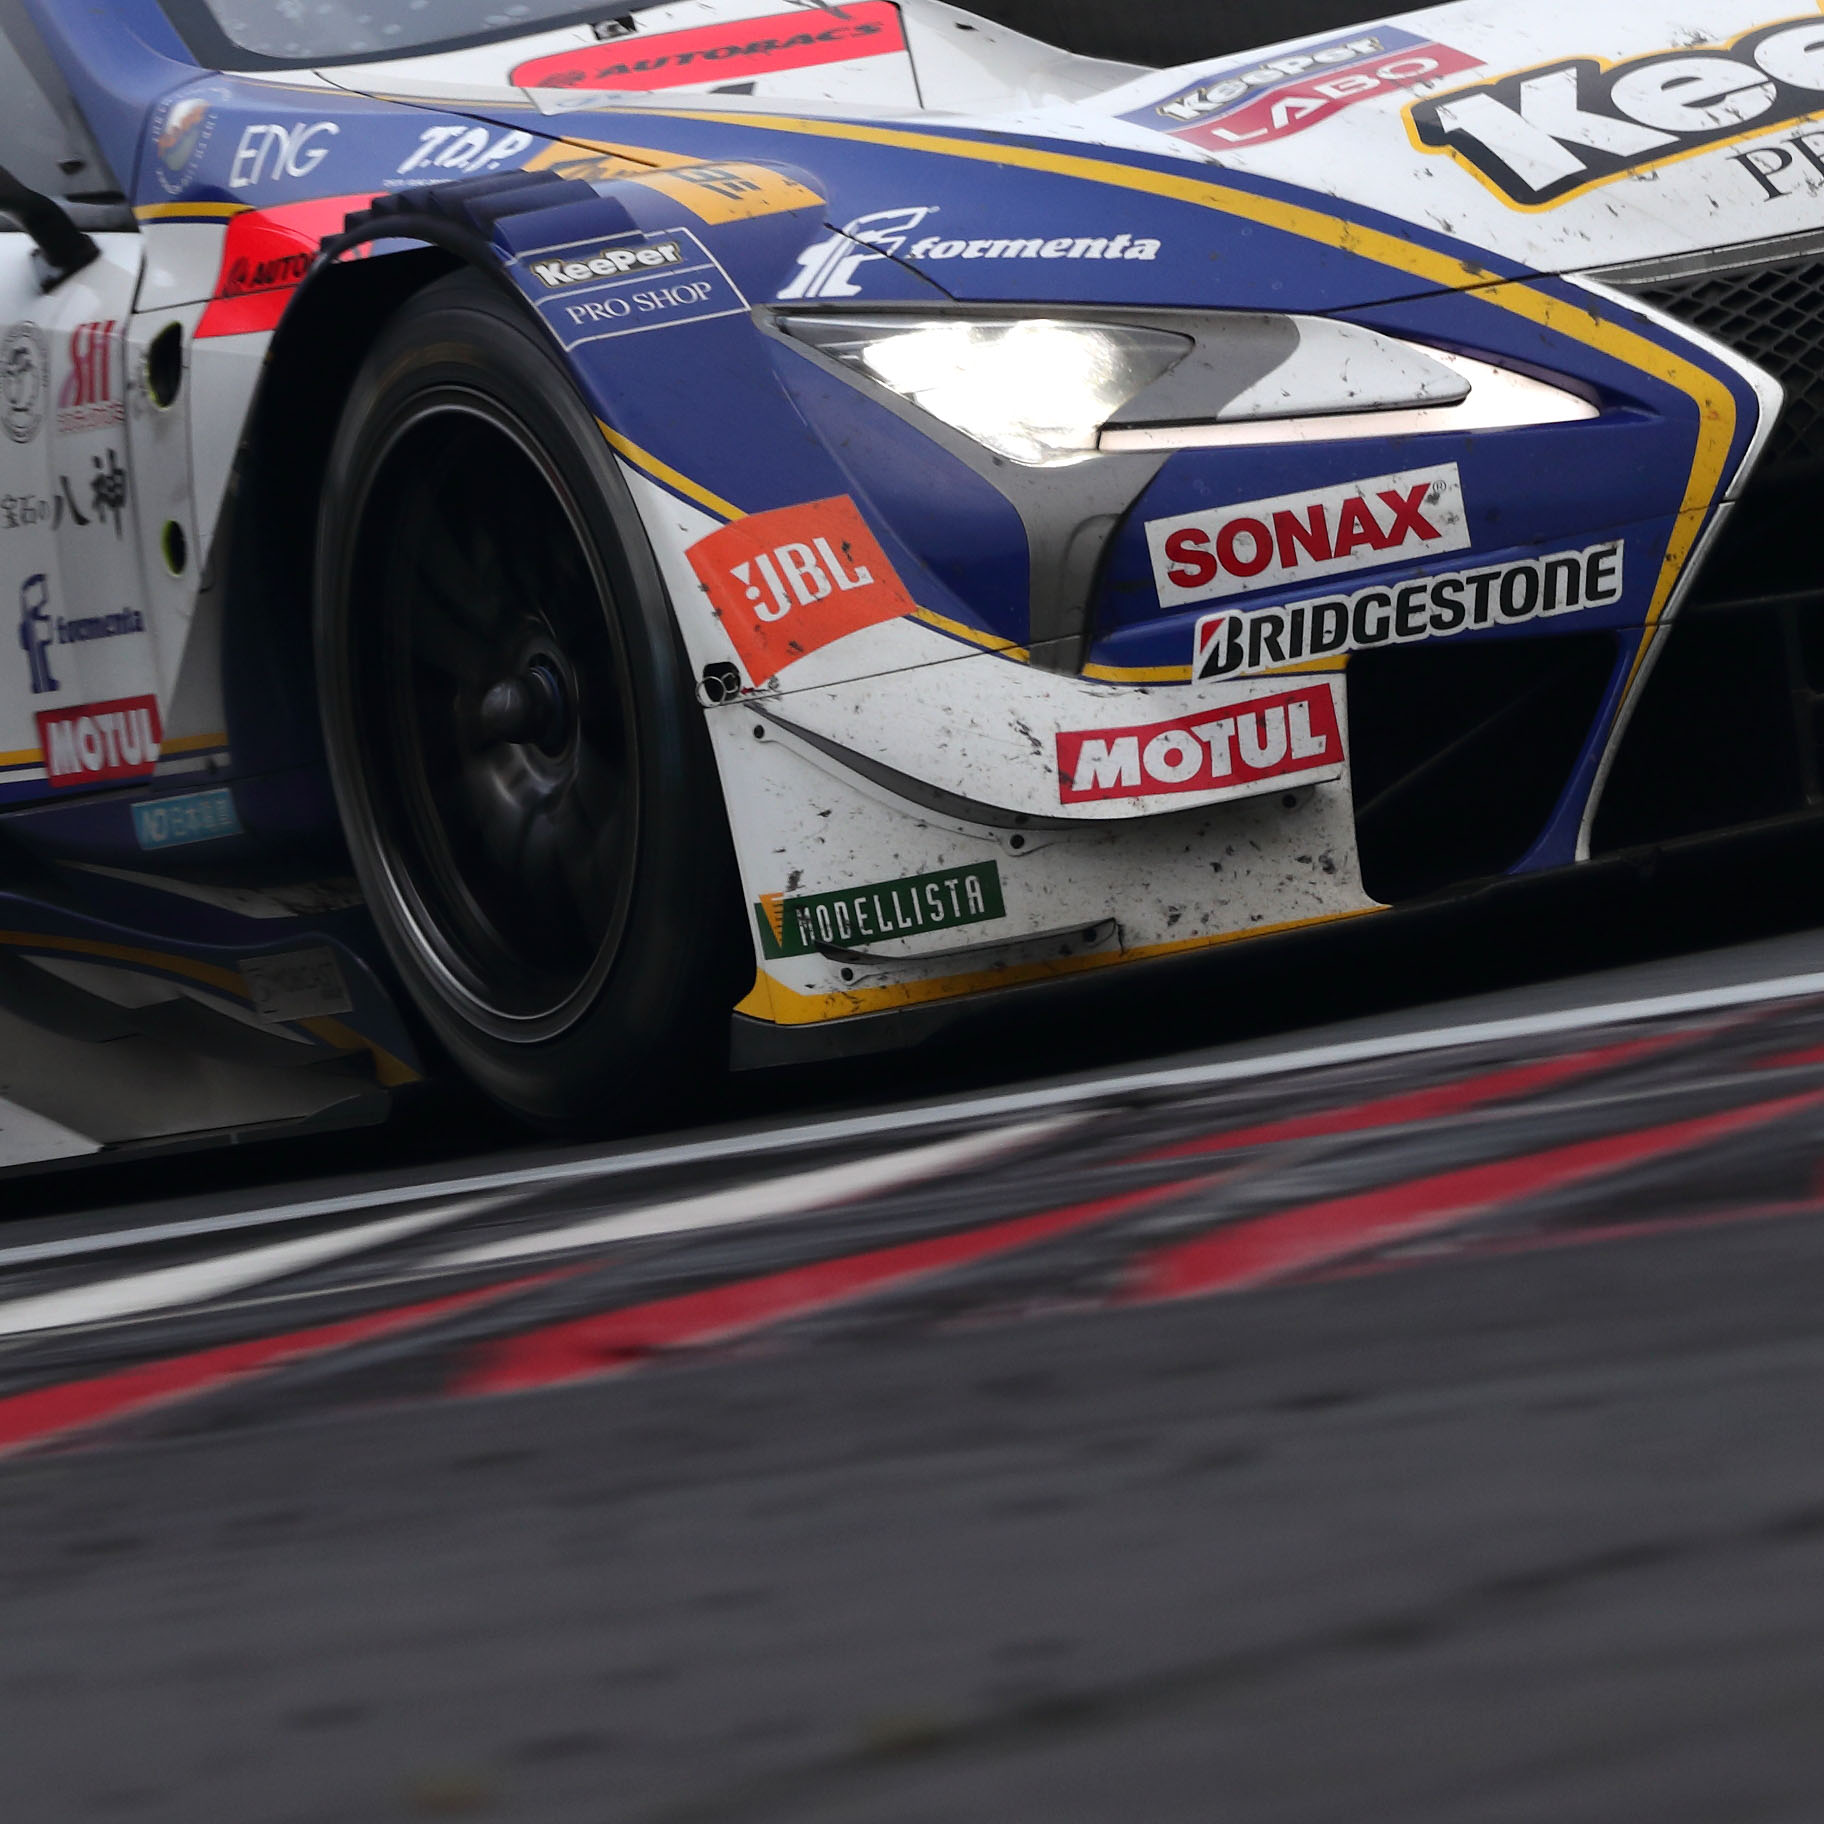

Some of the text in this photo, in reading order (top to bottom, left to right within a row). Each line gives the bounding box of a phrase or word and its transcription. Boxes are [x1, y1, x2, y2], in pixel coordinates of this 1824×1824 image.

[596, 20, 886, 79] AUTOBACS
[1155, 37, 1386, 122] KeePer
[1210, 56, 1440, 142] LABO
[229, 121, 340, 189] ENG
[534, 241, 682, 288] KeePer
[566, 280, 714, 326] PRO SHOP
[1165, 482, 1442, 589] SONAX
[729, 534, 873, 624] JBL
[1198, 542, 1622, 680] BRIDGESTONE
[47, 708, 160, 776] MOTUL
[1069, 700, 1329, 790] MOTUL
[797, 875, 986, 948] MODELLISTA
